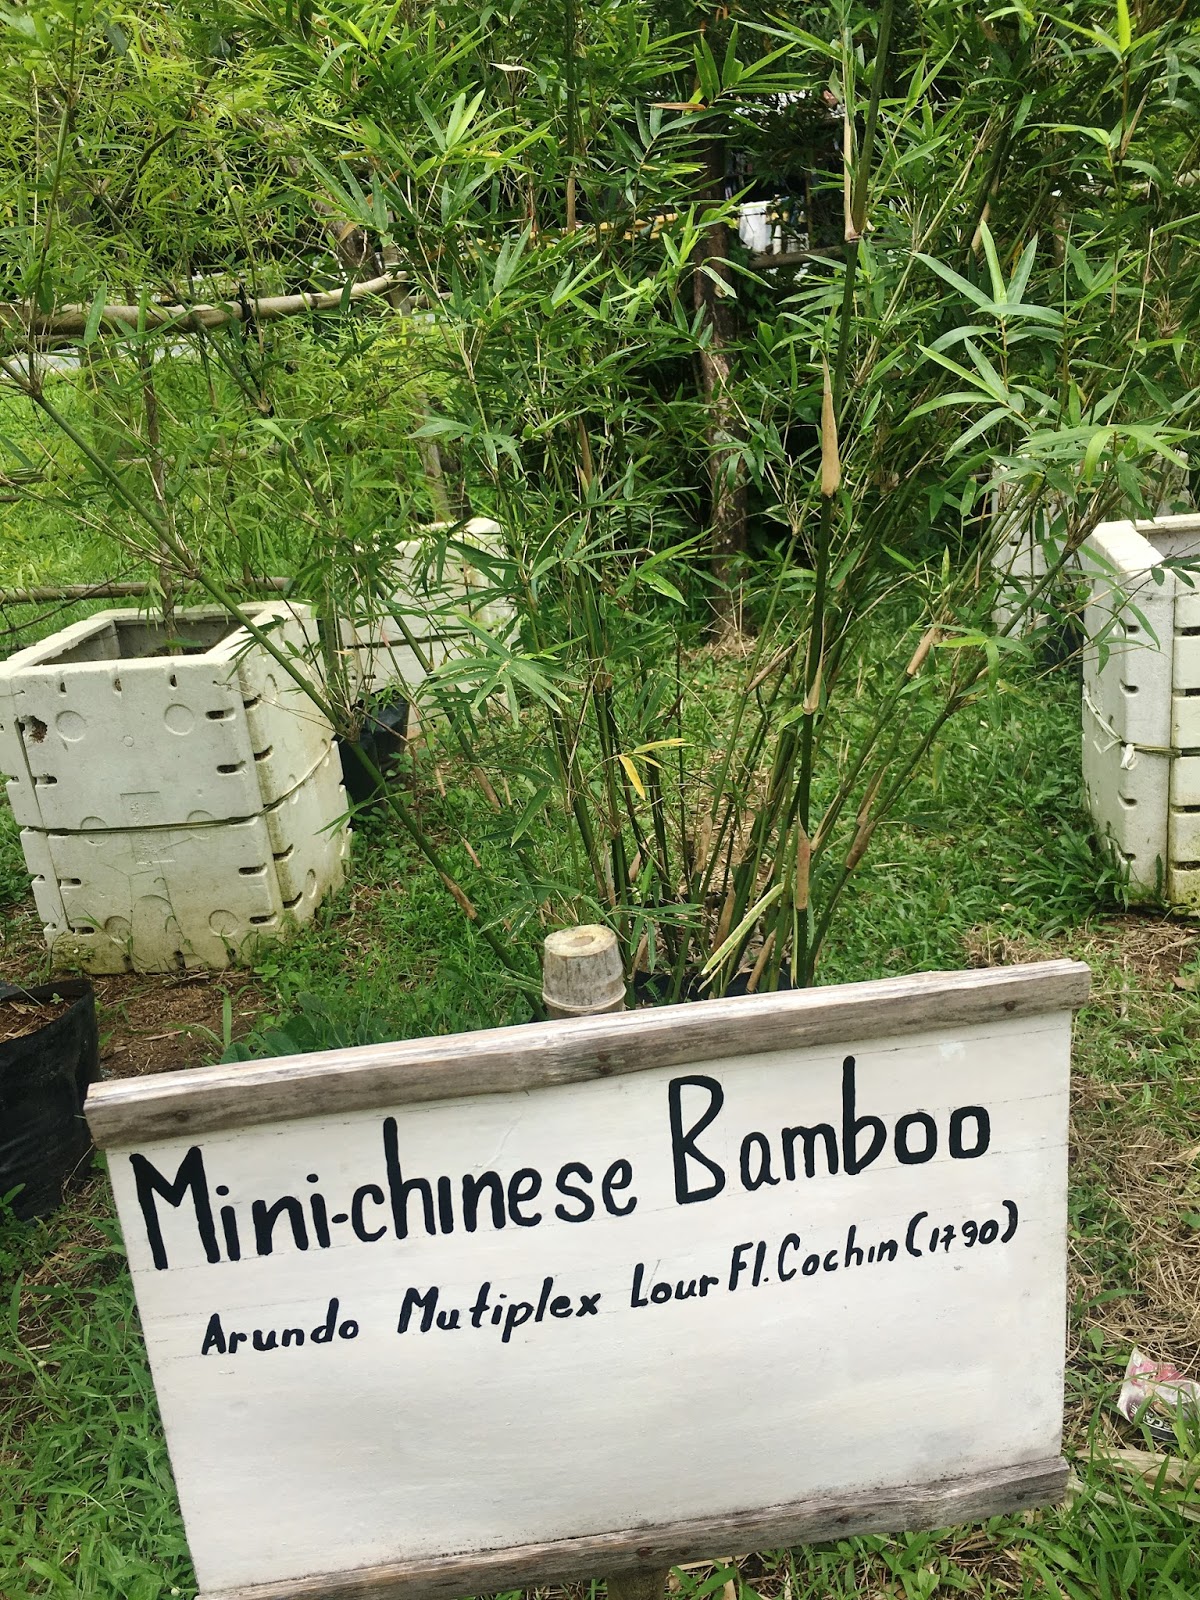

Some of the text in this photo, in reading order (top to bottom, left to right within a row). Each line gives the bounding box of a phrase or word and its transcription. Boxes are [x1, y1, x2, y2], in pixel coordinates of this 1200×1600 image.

[128, 1055, 991, 1271] Mini-chinese Bamboo
[201, 1297, 359, 1356] Arundo
[396, 1276, 602, 1344] Mutiplex
